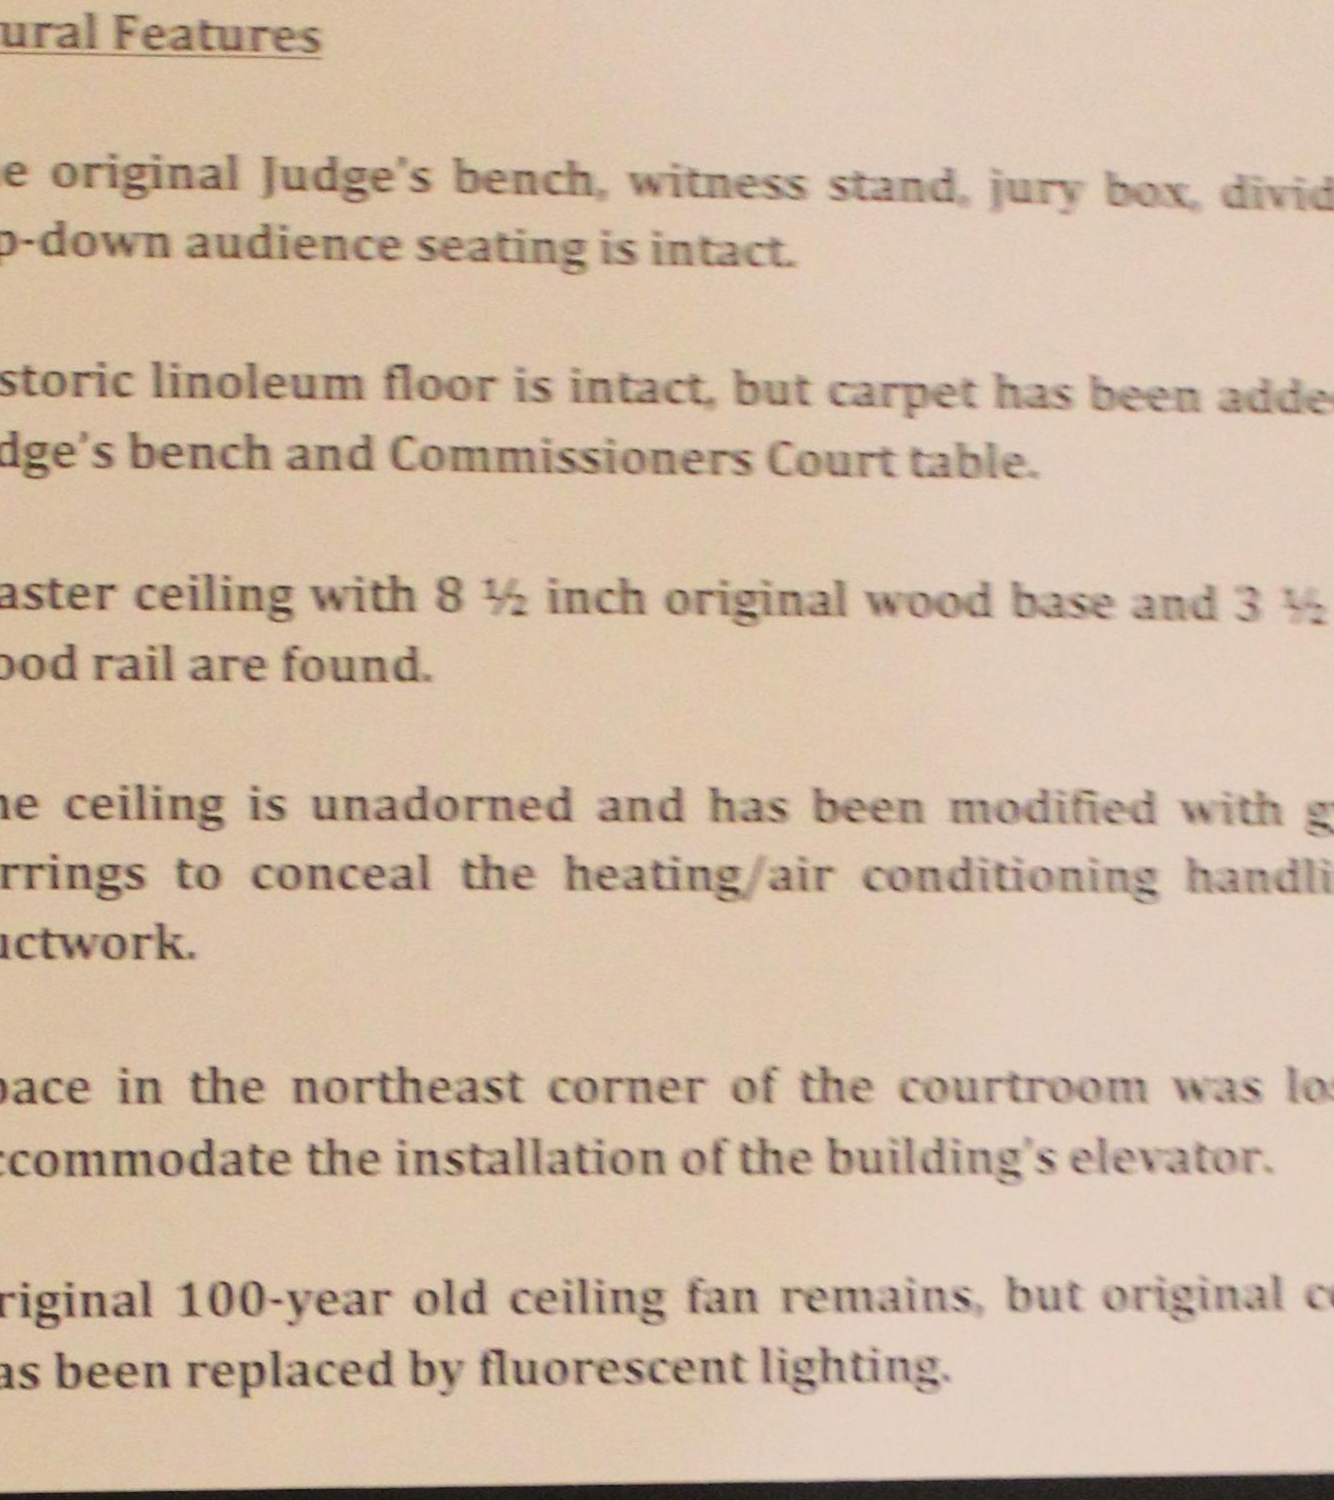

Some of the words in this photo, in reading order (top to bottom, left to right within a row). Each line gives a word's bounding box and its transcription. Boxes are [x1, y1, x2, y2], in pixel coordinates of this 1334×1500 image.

[113, 11, 323, 56] Features
[49, 151, 240, 202] original
[261, 153, 433, 204] Judge's
[452, 155, 608, 200] bench,
[627, 162, 808, 202] witness
[828, 165, 969, 206] stand,
[990, 167, 1084, 216] jury
[1104, 169, 1200, 212] box,
[184, 220, 403, 263] audience
[415, 228, 589, 277] seating
[600, 228, 639, 267] is
[650, 229, 797, 269] intact.
[150, 358, 366, 402] linoleum
[382, 360, 499, 403] floor
[514, 365, 554, 405] is
[569, 366, 717, 409] intact,
[732, 367, 812, 408] but
[826, 377, 979, 421] carpet
[993, 371, 1074, 411] has
[1089, 374, 1203, 414] been
[127, 430, 273, 472] bench
[284, 431, 376, 473] and
[388, 432, 755, 477] Commissioners
[765, 437, 898, 480] Court
[908, 439, 1039, 481] table.
[133, 572, 295, 624] ceiling
[309, 572, 418, 614] with
[434, 573, 465, 614] 8
[547, 575, 647, 617] inch
[663, 578, 848, 628] original
[864, 580, 994, 620] wood
[1010, 579, 1116, 621] base
[1131, 582, 1219, 622] and
[1235, 584, 1262, 624] 3
[92, 642, 176, 683] rail
[187, 652, 269, 684] are
[281, 642, 433, 684] found.
[63, 782, 226, 833] ceiling
[248, 783, 288, 822] is
[310, 783, 575, 824] unadorned
[596, 784, 686, 824] and
[708, 784, 790, 825] has
[812, 786, 926, 825] been
[949, 787, 1158, 826] modified
[1179, 789, 1284, 827] with
[174, 856, 224, 891] to
[249, 852, 432, 893] conceal
[460, 852, 537, 892] the
[563, 852, 836, 903] heating/air
[860, 854, 1160, 904] conditioning
[117, 1066, 164, 1106] in
[188, 1064, 266, 1106] the
[291, 1064, 524, 1106] northeast
[547, 1074, 708, 1105] corner
[730, 1063, 780, 1104] of
[798, 1063, 875, 1104] the
[898, 1071, 1149, 1105] courtroom
[1172, 1076, 1263, 1104] was
[305, 1136, 382, 1178] the
[395, 1134, 668, 1177] installation
[679, 1136, 732, 1178] of
[736, 1137, 815, 1178] the
[825, 1133, 1060, 1187] building's
[1068, 1135, 1276, 1178] elevator.
[179, 1279, 394, 1328] 100-year
[412, 1276, 488, 1317] old
[508, 1276, 668, 1327] ceiling
[686, 1275, 759, 1315] fan
[779, 1275, 986, 1320] remains,
[1005, 1274, 1082, 1312] but
[1101, 1273, 1284, 1323] original
[53, 1349, 172, 1391] been
[186, 1347, 395, 1400] replaced
[408, 1346, 465, 1398] by
[478, 1345, 746, 1387] fluorescent
[759, 1344, 951, 1396] lighting.
